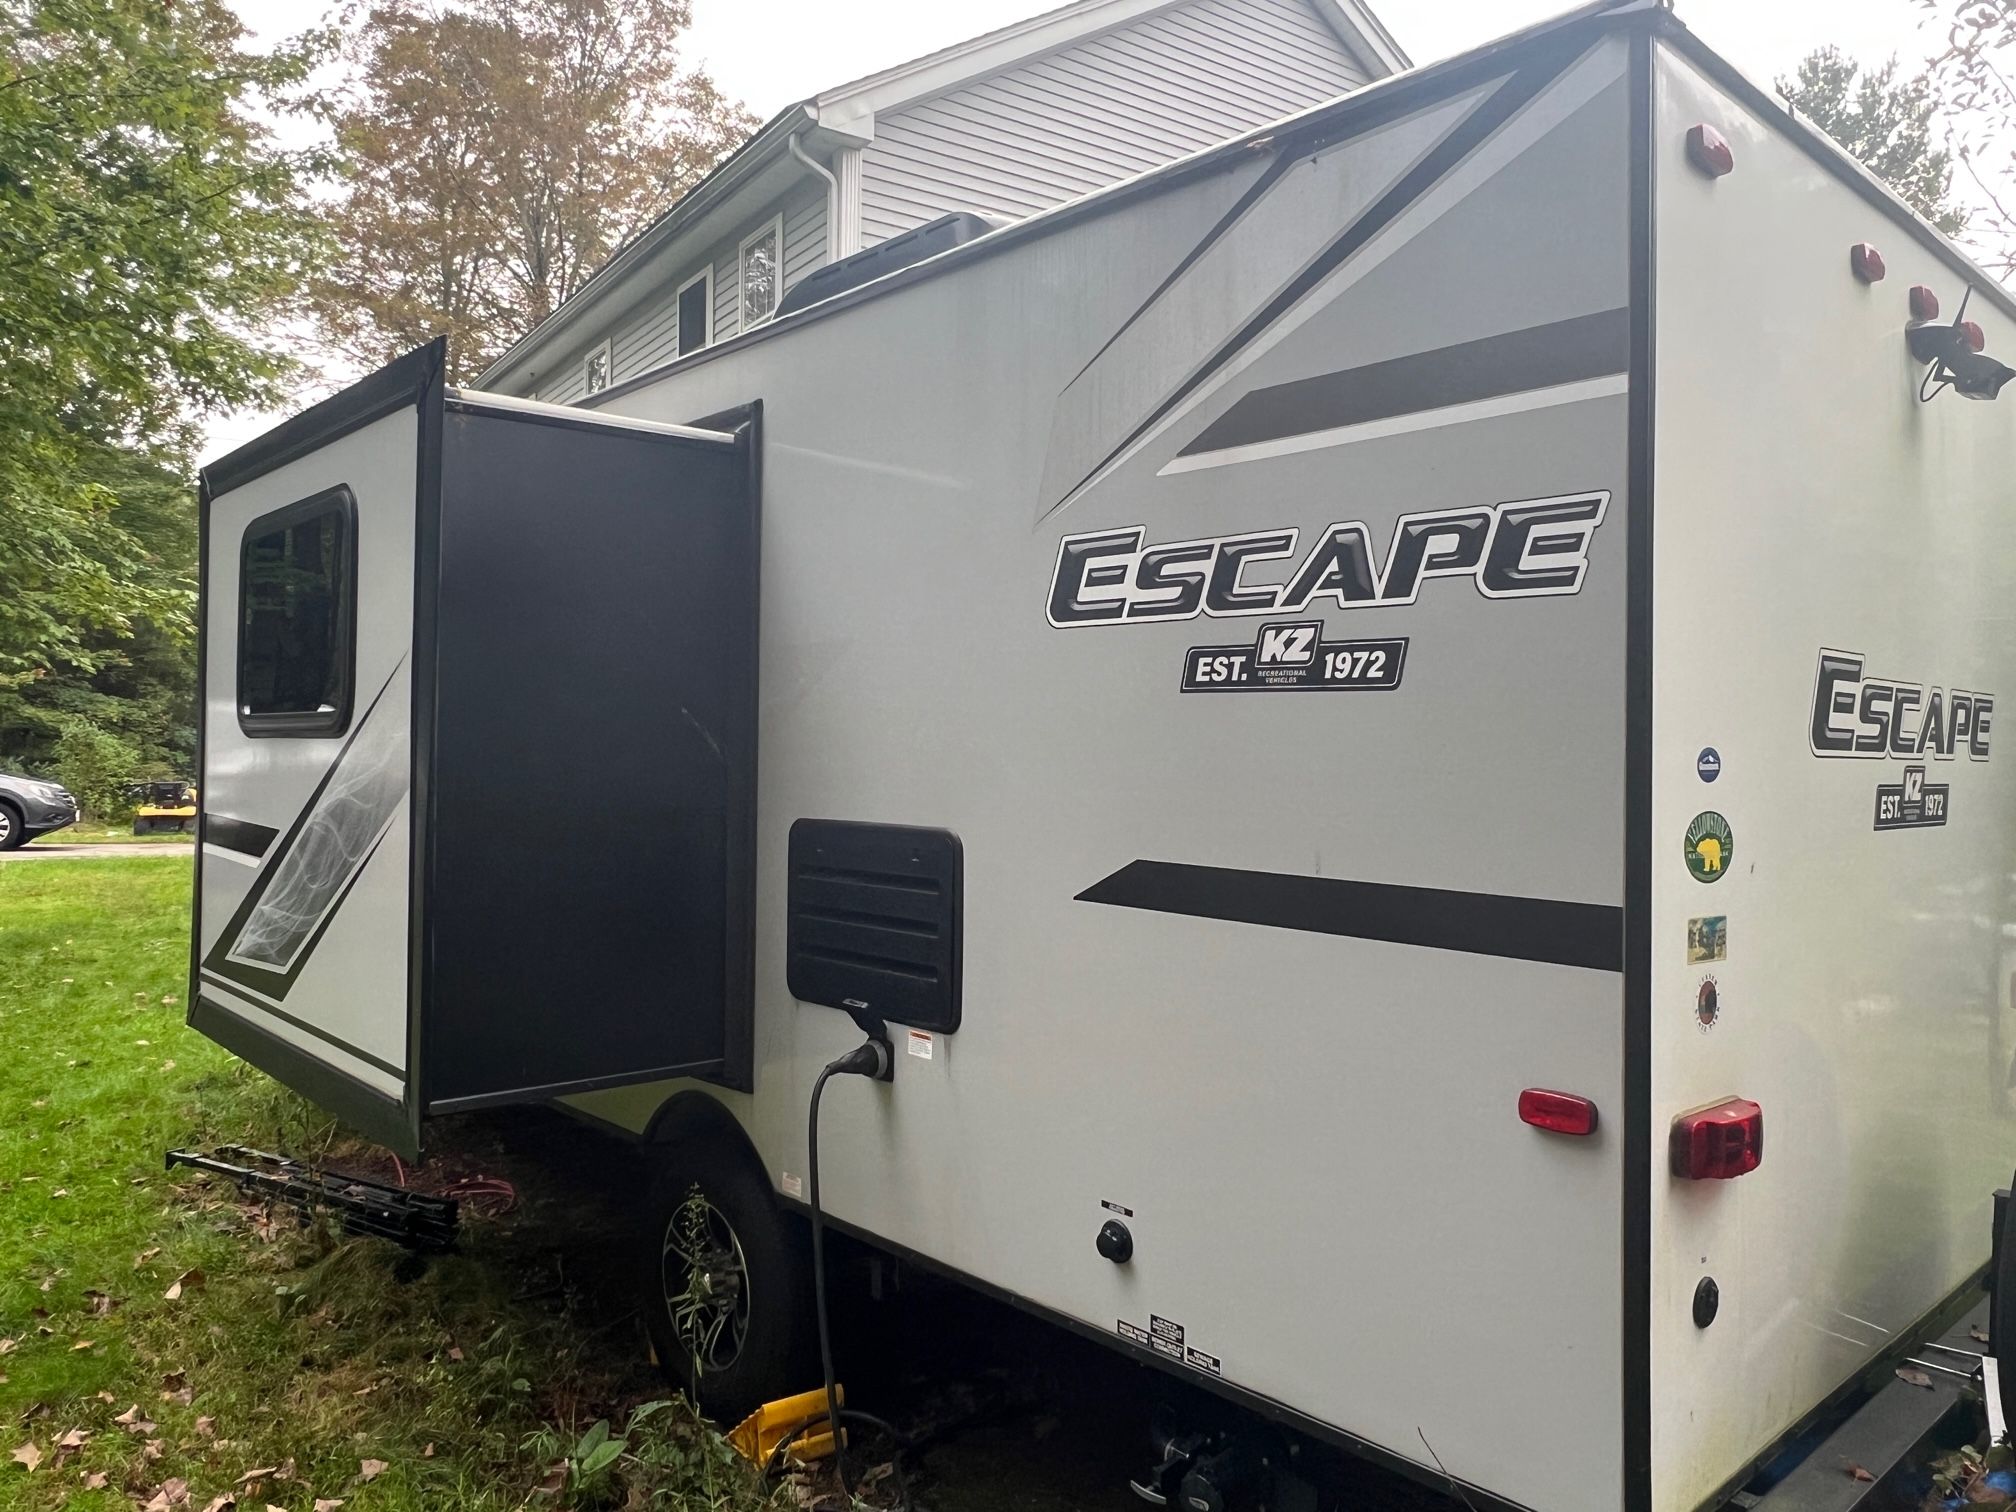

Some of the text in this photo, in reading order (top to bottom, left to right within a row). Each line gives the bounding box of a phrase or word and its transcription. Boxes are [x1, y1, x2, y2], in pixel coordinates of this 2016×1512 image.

[1046, 490, 1611, 628] ESCAPE
[1260, 627, 1315, 662] KZ
[1195, 650, 1386, 682] EST. 1972
[1810, 648, 1994, 761] ESCAPE
[1904, 772, 1923, 802] KZ
[1880, 794, 1944, 819] EST. 1972
